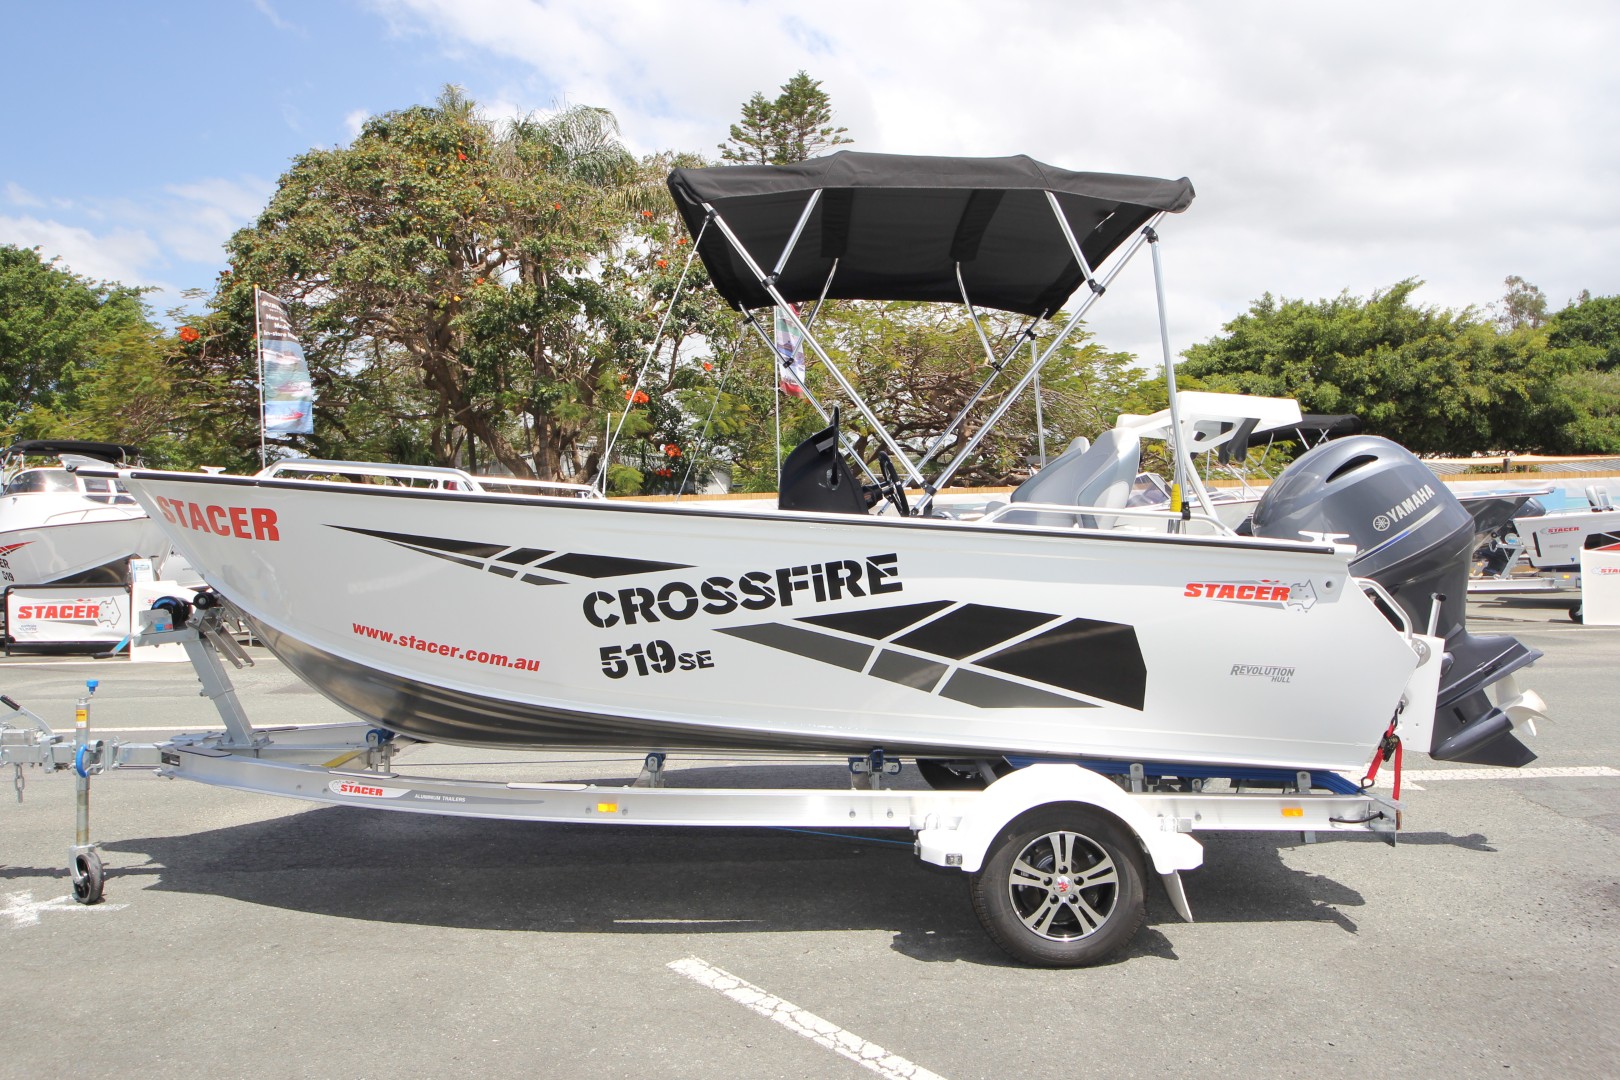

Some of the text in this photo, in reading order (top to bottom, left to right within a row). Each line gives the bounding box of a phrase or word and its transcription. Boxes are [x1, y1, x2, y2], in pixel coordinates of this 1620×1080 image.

[1386, 484, 1435, 522] YAMAHA
[156, 496, 280, 541] STACER
[583, 553, 903, 628] CROSSFIRE
[1184, 583, 1290, 601] STACER
[18, 605, 100, 620] STACER
[352, 622, 540, 672] www.stacer.com.au
[1271, 676, 1290, 684] HULL
[340, 784, 383, 796] STACER
